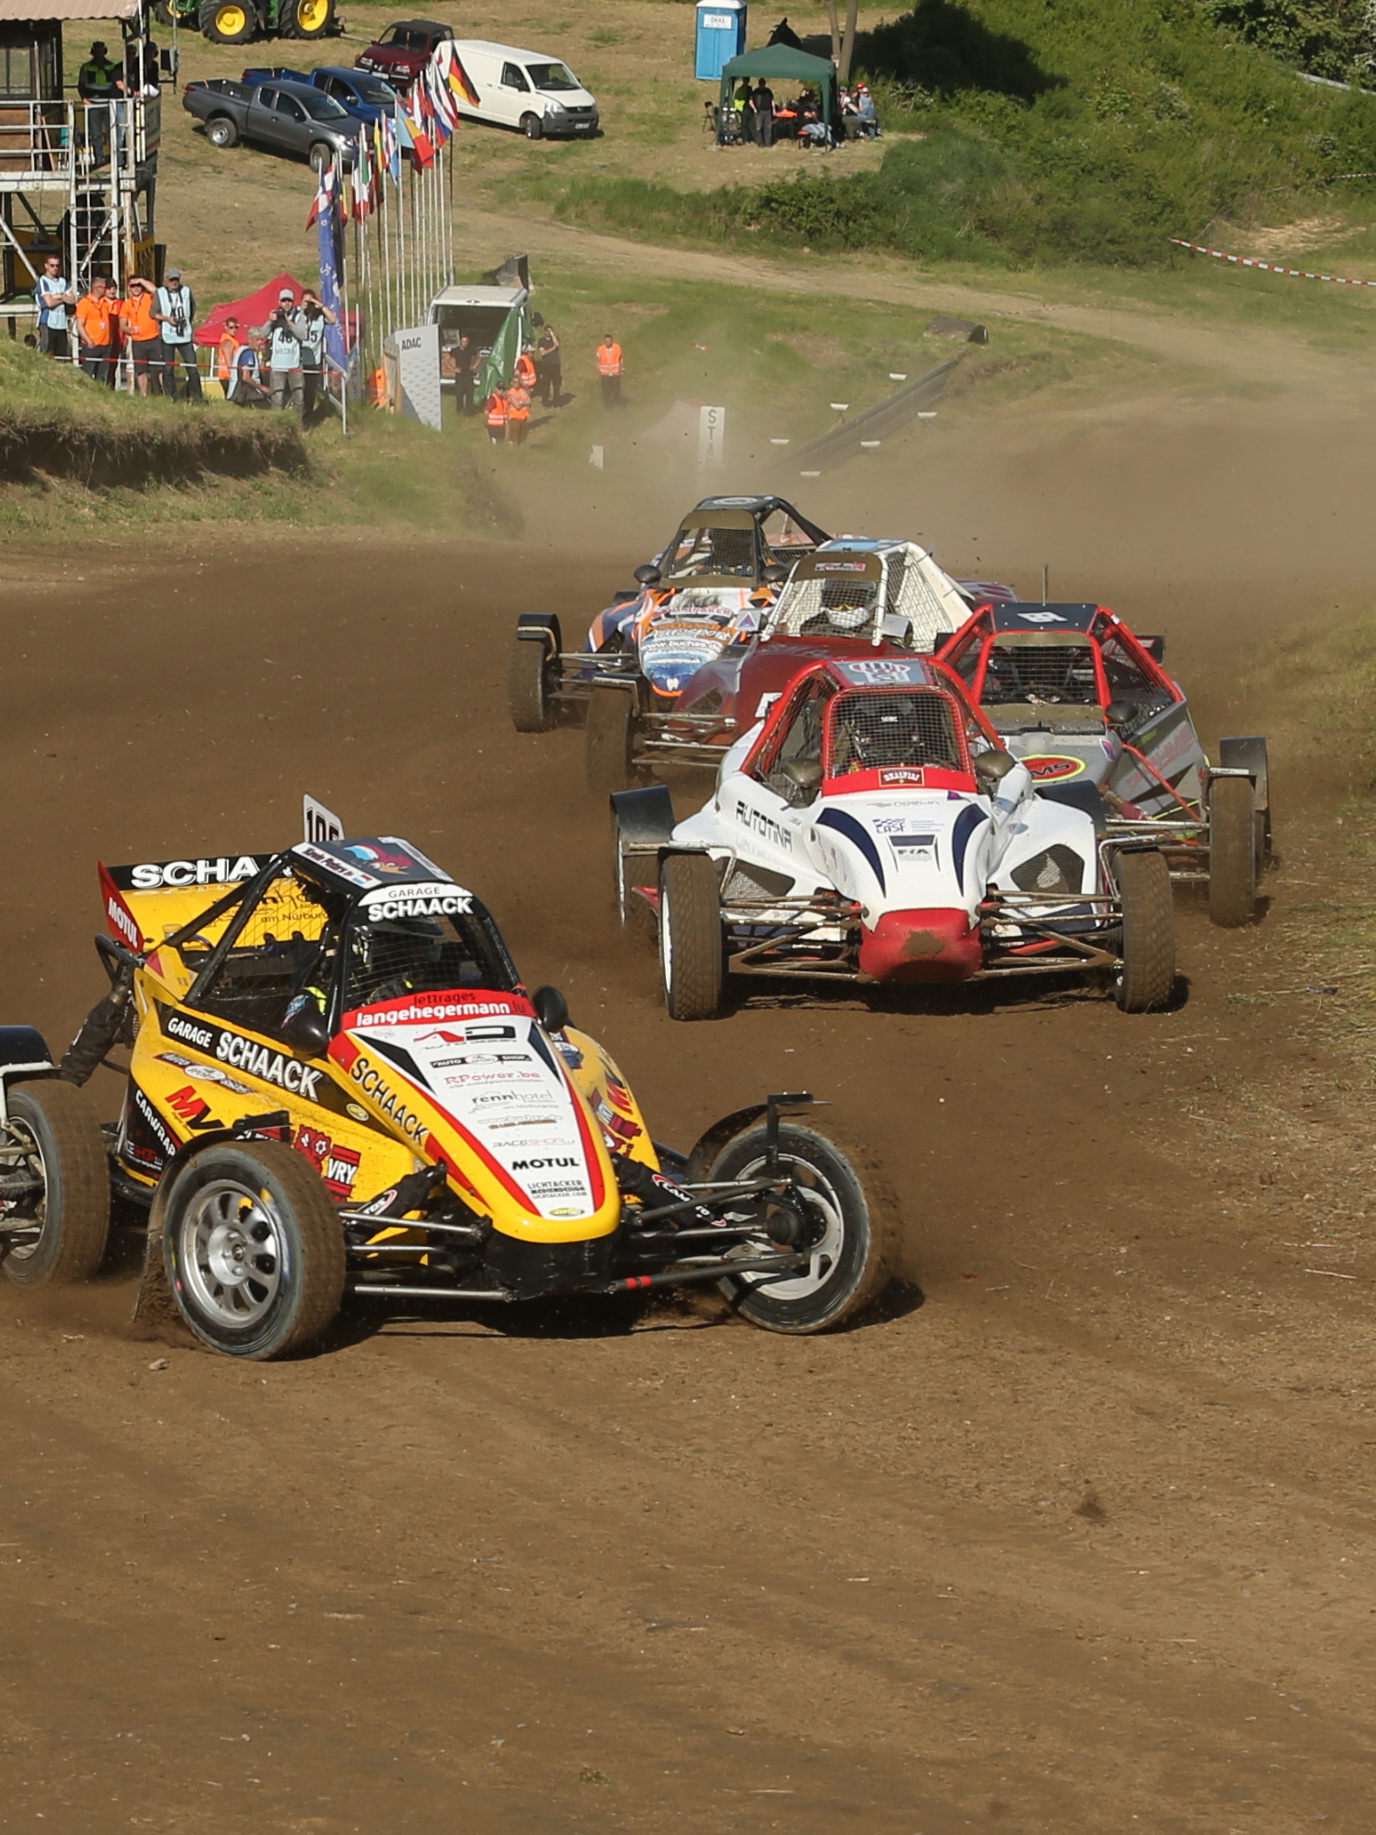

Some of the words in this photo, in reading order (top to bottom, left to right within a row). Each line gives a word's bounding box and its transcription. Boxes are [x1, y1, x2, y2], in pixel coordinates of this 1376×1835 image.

[401, 337, 422, 351] ADAC
[131, 854, 292, 889] SCHA
[388, 886, 441, 899] GARAGE
[108, 897, 139, 948] MOTUL
[368, 897, 474, 922] SCHAACK
[168, 1017, 214, 1049] GARAGE
[216, 1031, 324, 1103] SCHAACK
[350, 1057, 429, 1147] SCHAACK
[327, 1157, 358, 1185] VRY
[512, 1157, 580, 1171] MOTUL
